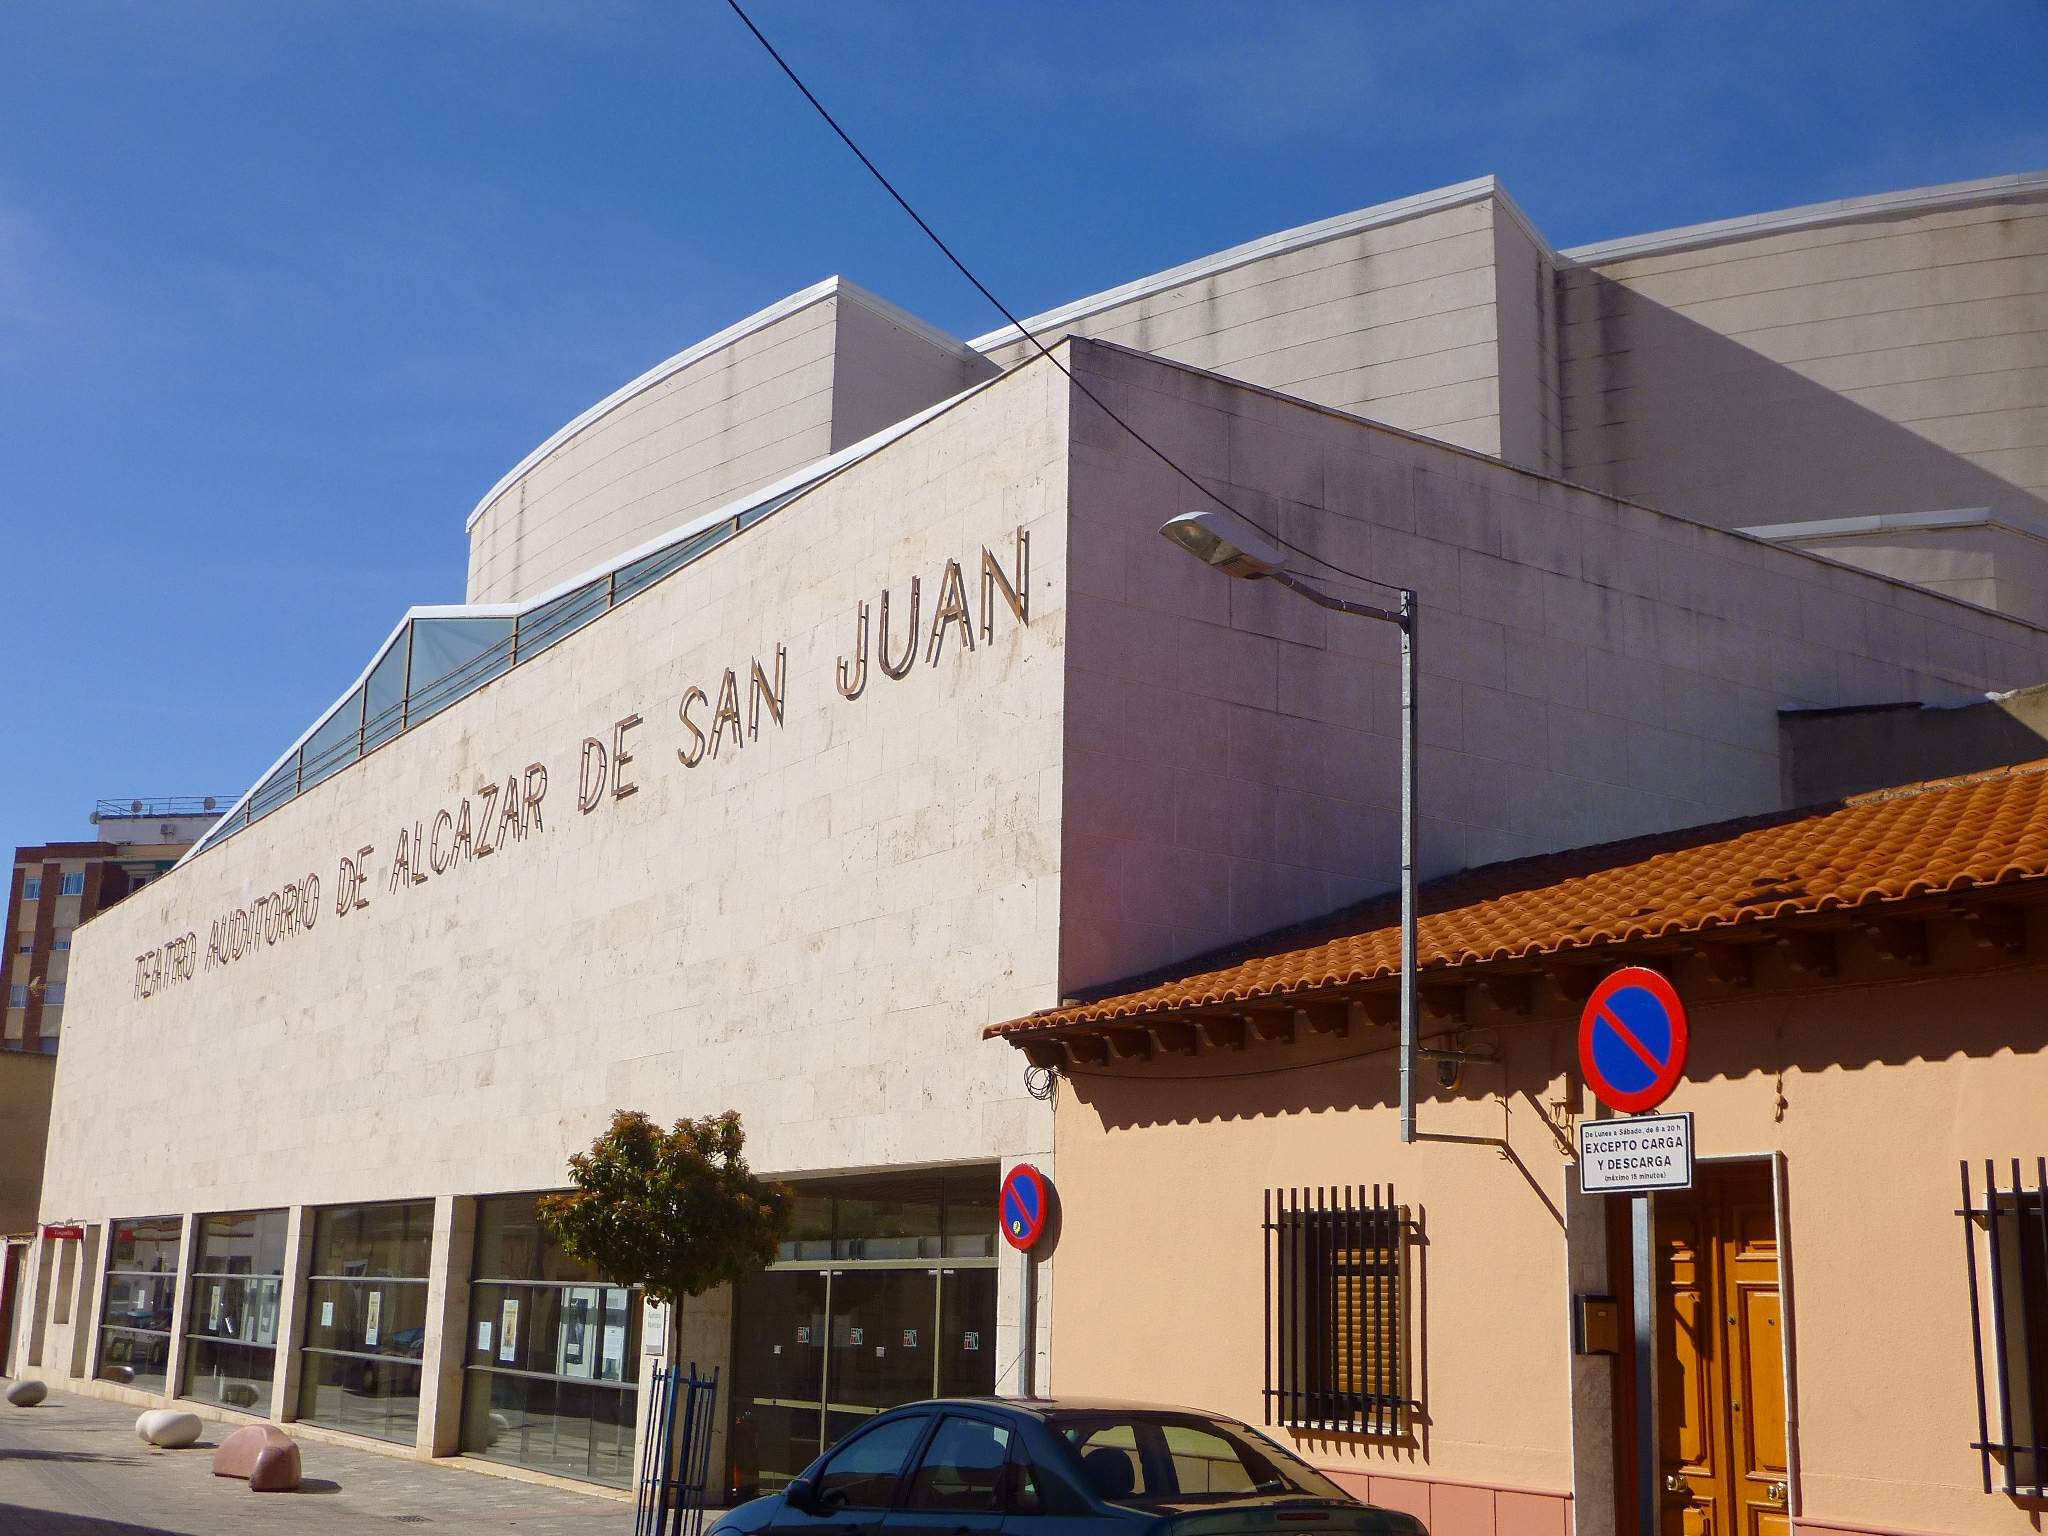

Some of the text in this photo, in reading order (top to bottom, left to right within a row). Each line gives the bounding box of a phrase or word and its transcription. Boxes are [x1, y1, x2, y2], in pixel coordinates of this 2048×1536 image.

[134, 525, 1030, 1000] TEATRO AUDITORIO DE ALCAZAR DE SAN JUAN
[1585, 1136, 1683, 1154] EXCEPTO CARGA
[1597, 1155, 1672, 1171] Y DESCARGA
[1639, 1171, 1667, 1179] minutos)
